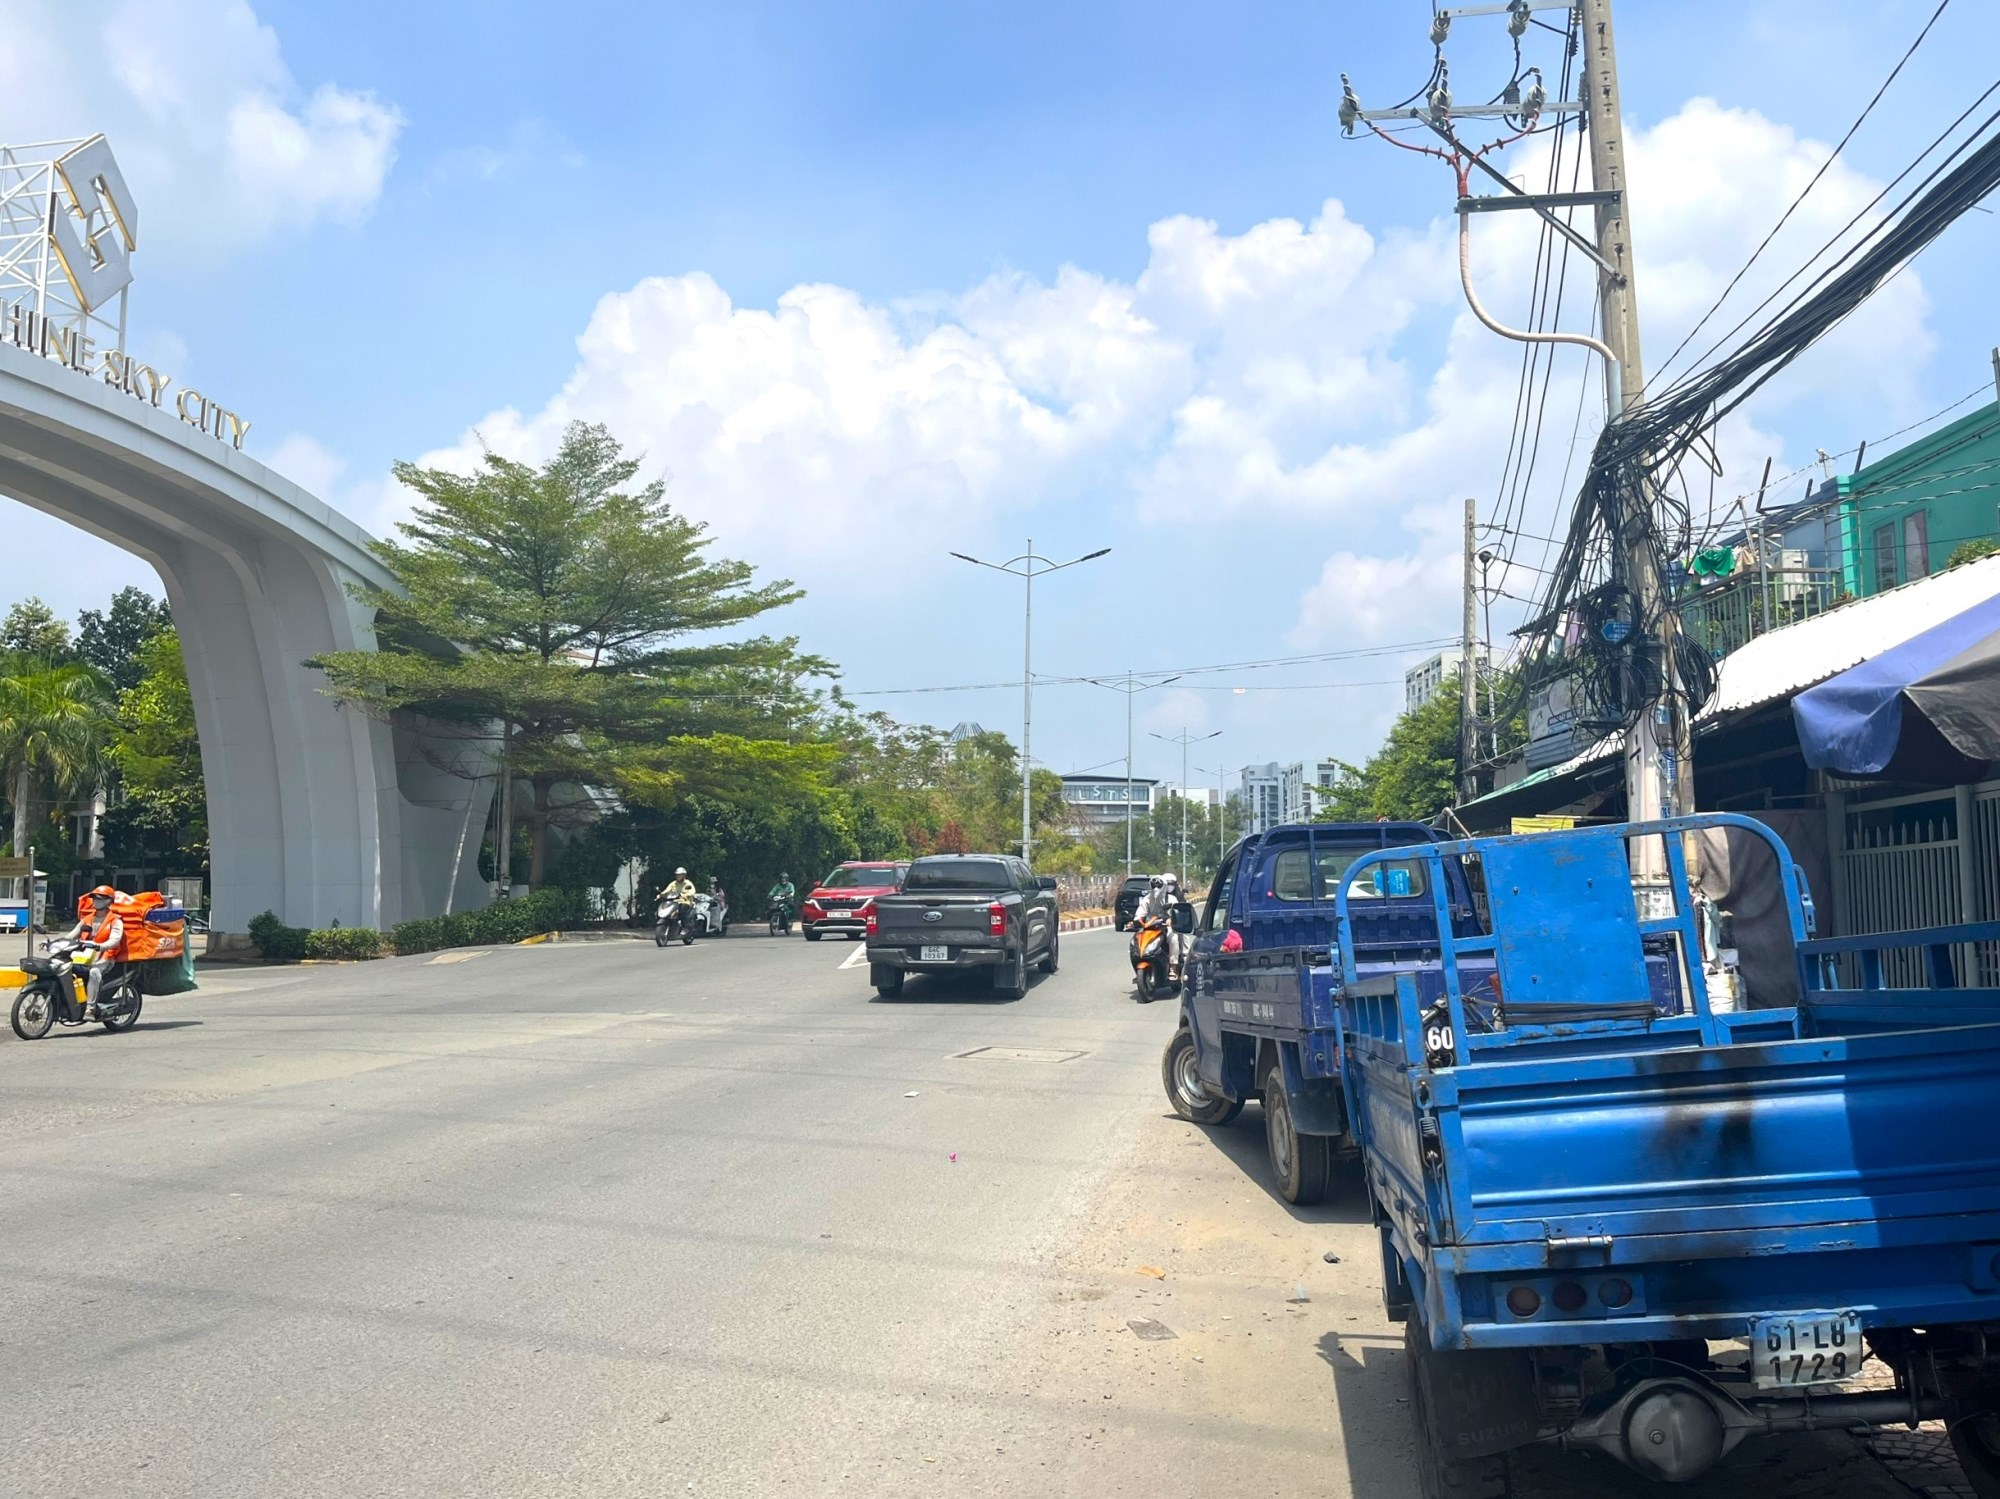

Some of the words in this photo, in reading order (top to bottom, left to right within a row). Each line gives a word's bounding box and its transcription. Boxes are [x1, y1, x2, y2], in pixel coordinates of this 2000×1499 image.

[105, 349, 172, 407] SKY
[177, 387, 252, 449] CITY
[1427, 1026, 1454, 1051] 60
[1766, 1319, 1846, 1352] 61-L8
[1769, 1351, 1847, 1383] 1729
[1457, 1419, 1529, 1446] SUZUKI
